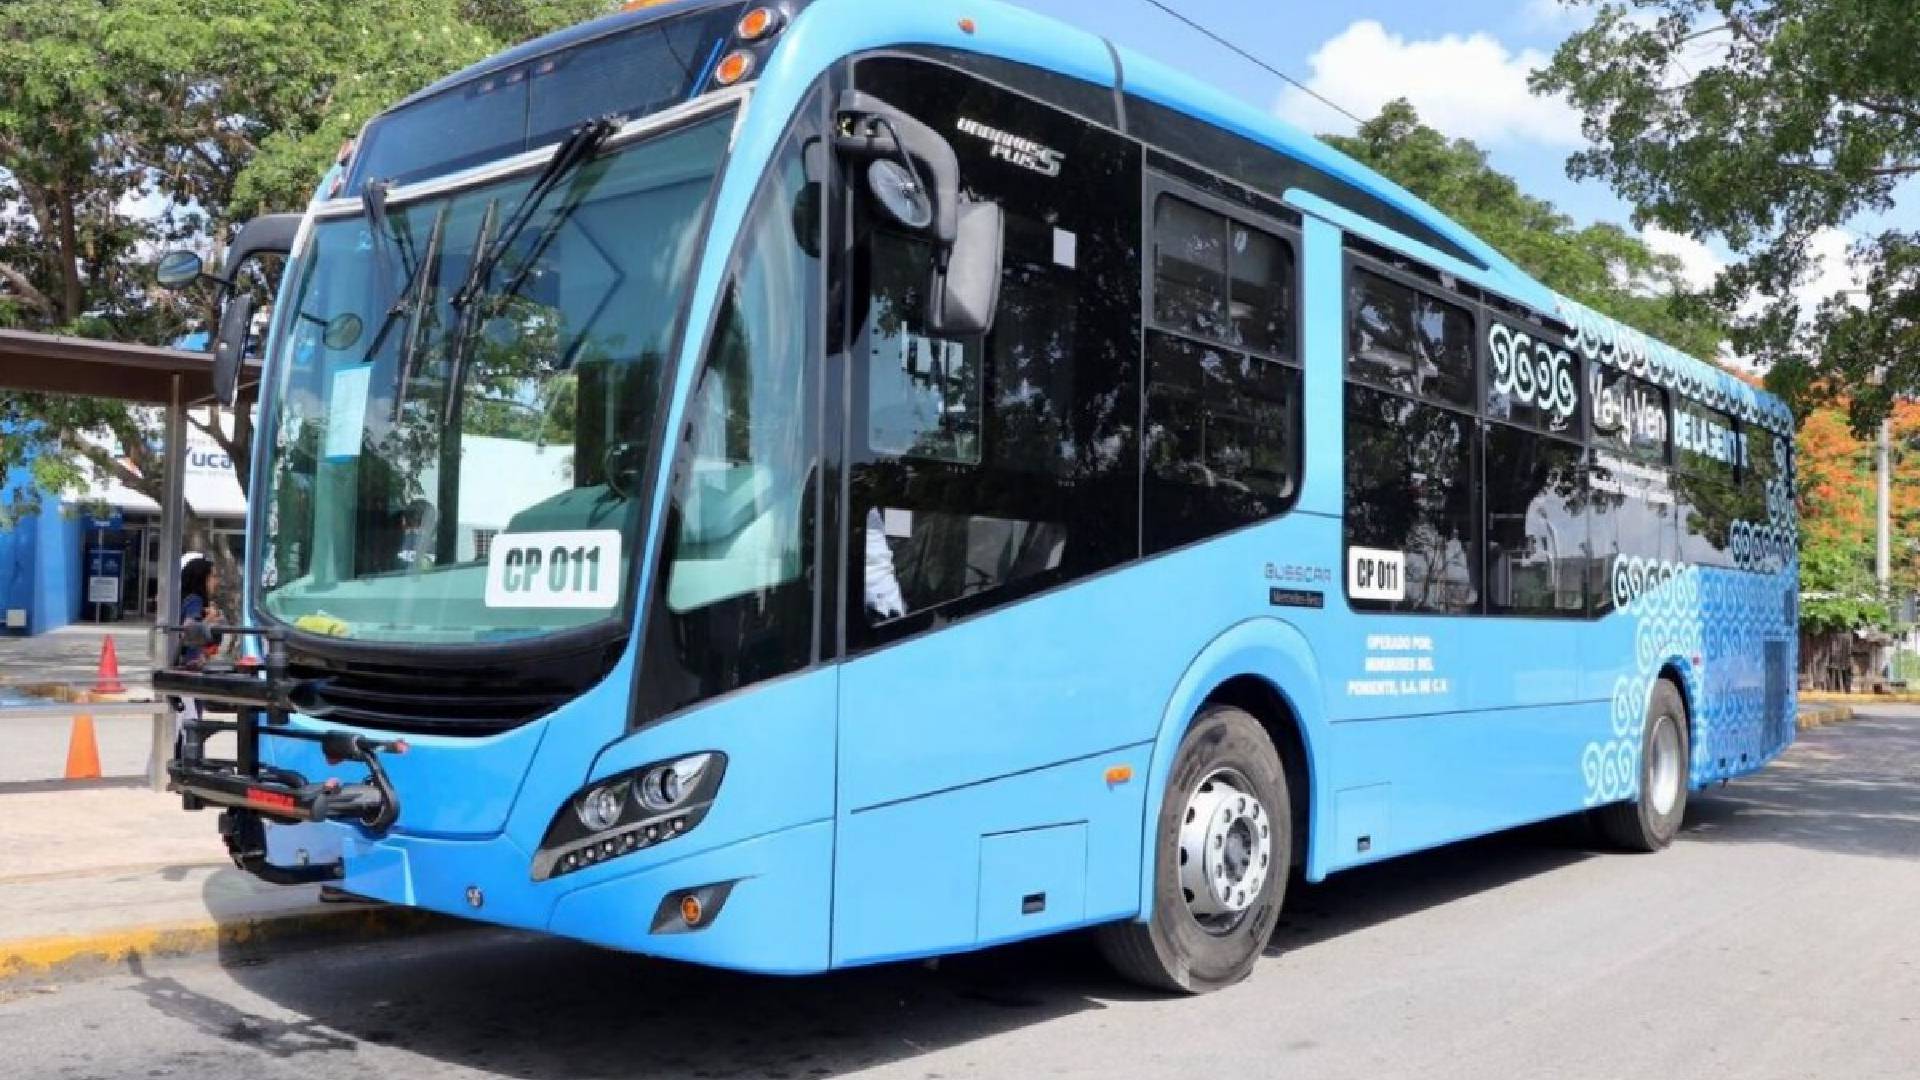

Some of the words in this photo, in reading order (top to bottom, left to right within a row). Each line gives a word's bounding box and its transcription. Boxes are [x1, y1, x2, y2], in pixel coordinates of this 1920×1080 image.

[503, 547, 542, 592] CP
[549, 545, 600, 592] 011
[1356, 558, 1375, 589] CP
[1377, 559, 1398, 591] 011
